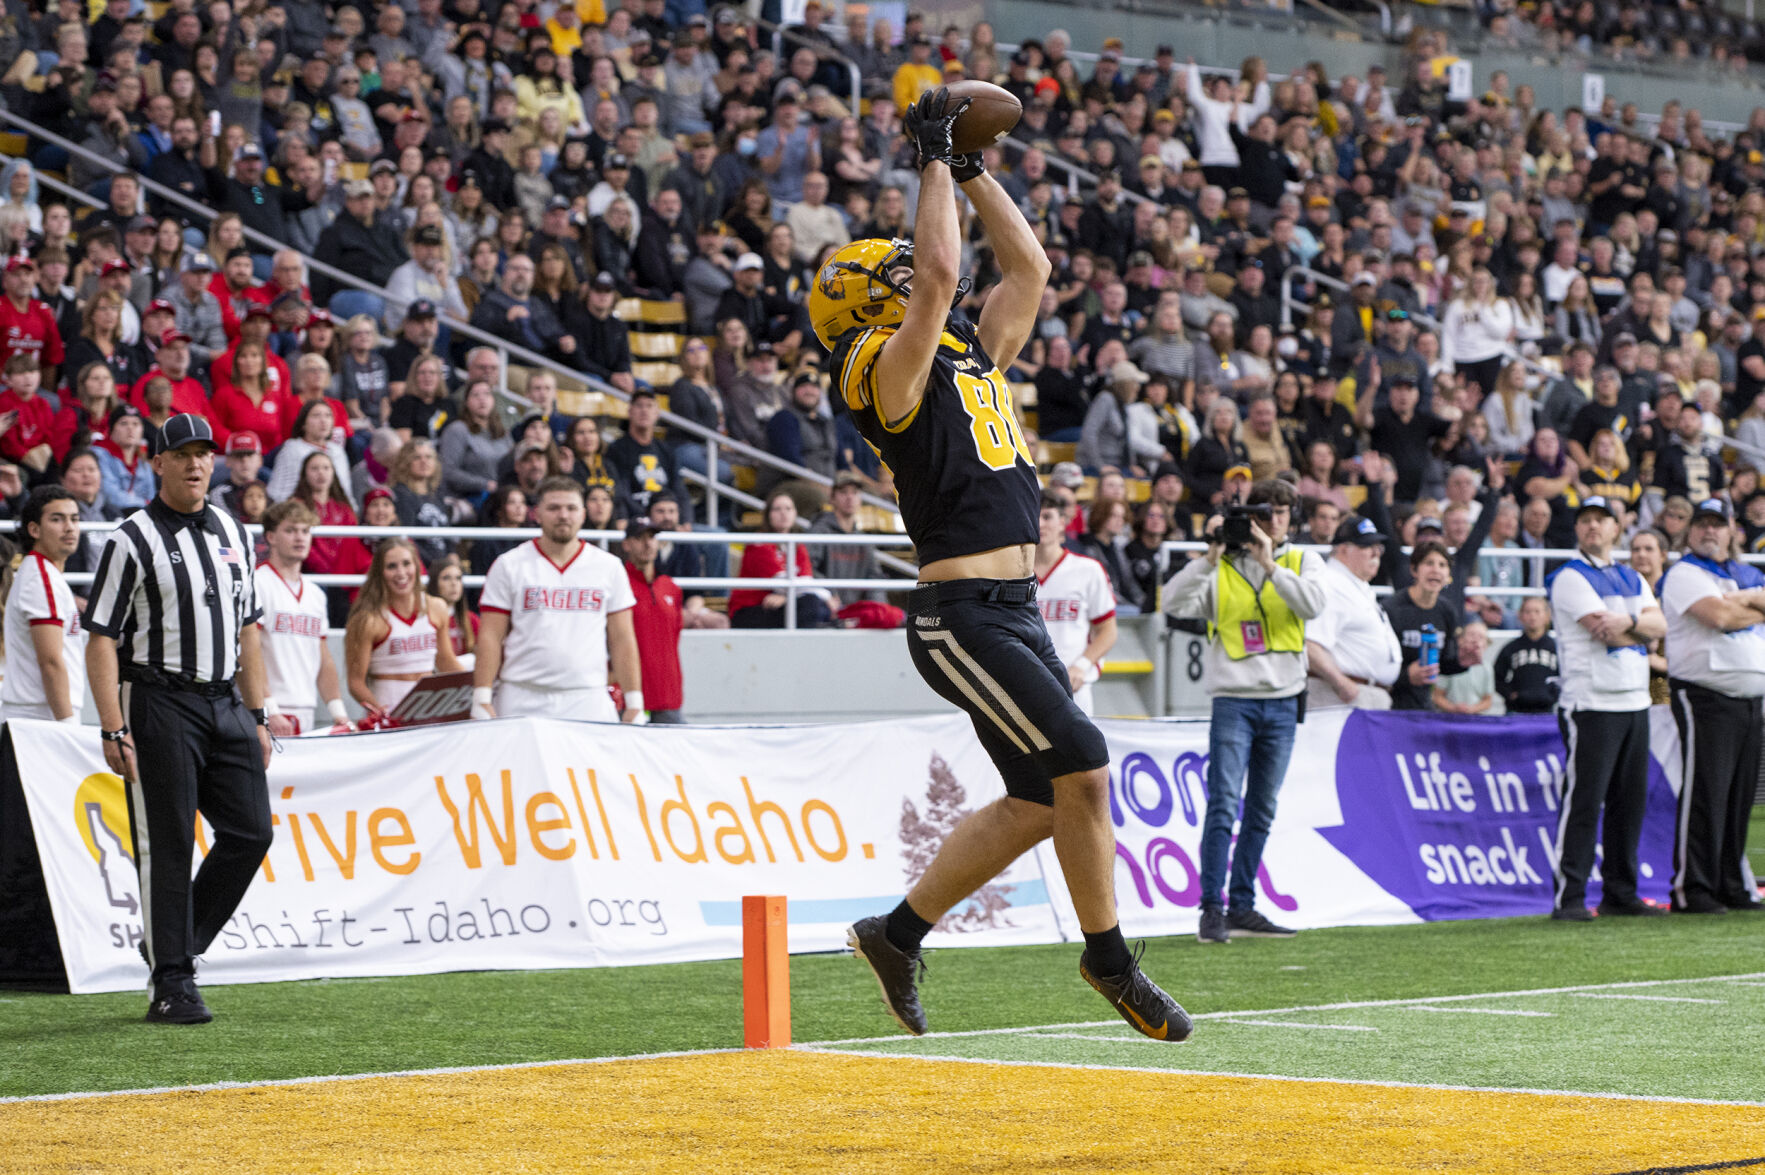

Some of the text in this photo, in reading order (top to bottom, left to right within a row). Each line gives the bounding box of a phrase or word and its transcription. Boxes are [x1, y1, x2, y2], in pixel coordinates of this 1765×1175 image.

[523, 587, 604, 611] EAGLES
[1188, 640, 1203, 682] 8
[1396, 752, 1477, 813] Life
[1478, 756, 1530, 813] in
[195, 767, 876, 882] rive Well Idaho.
[1419, 827, 1543, 885] snack
